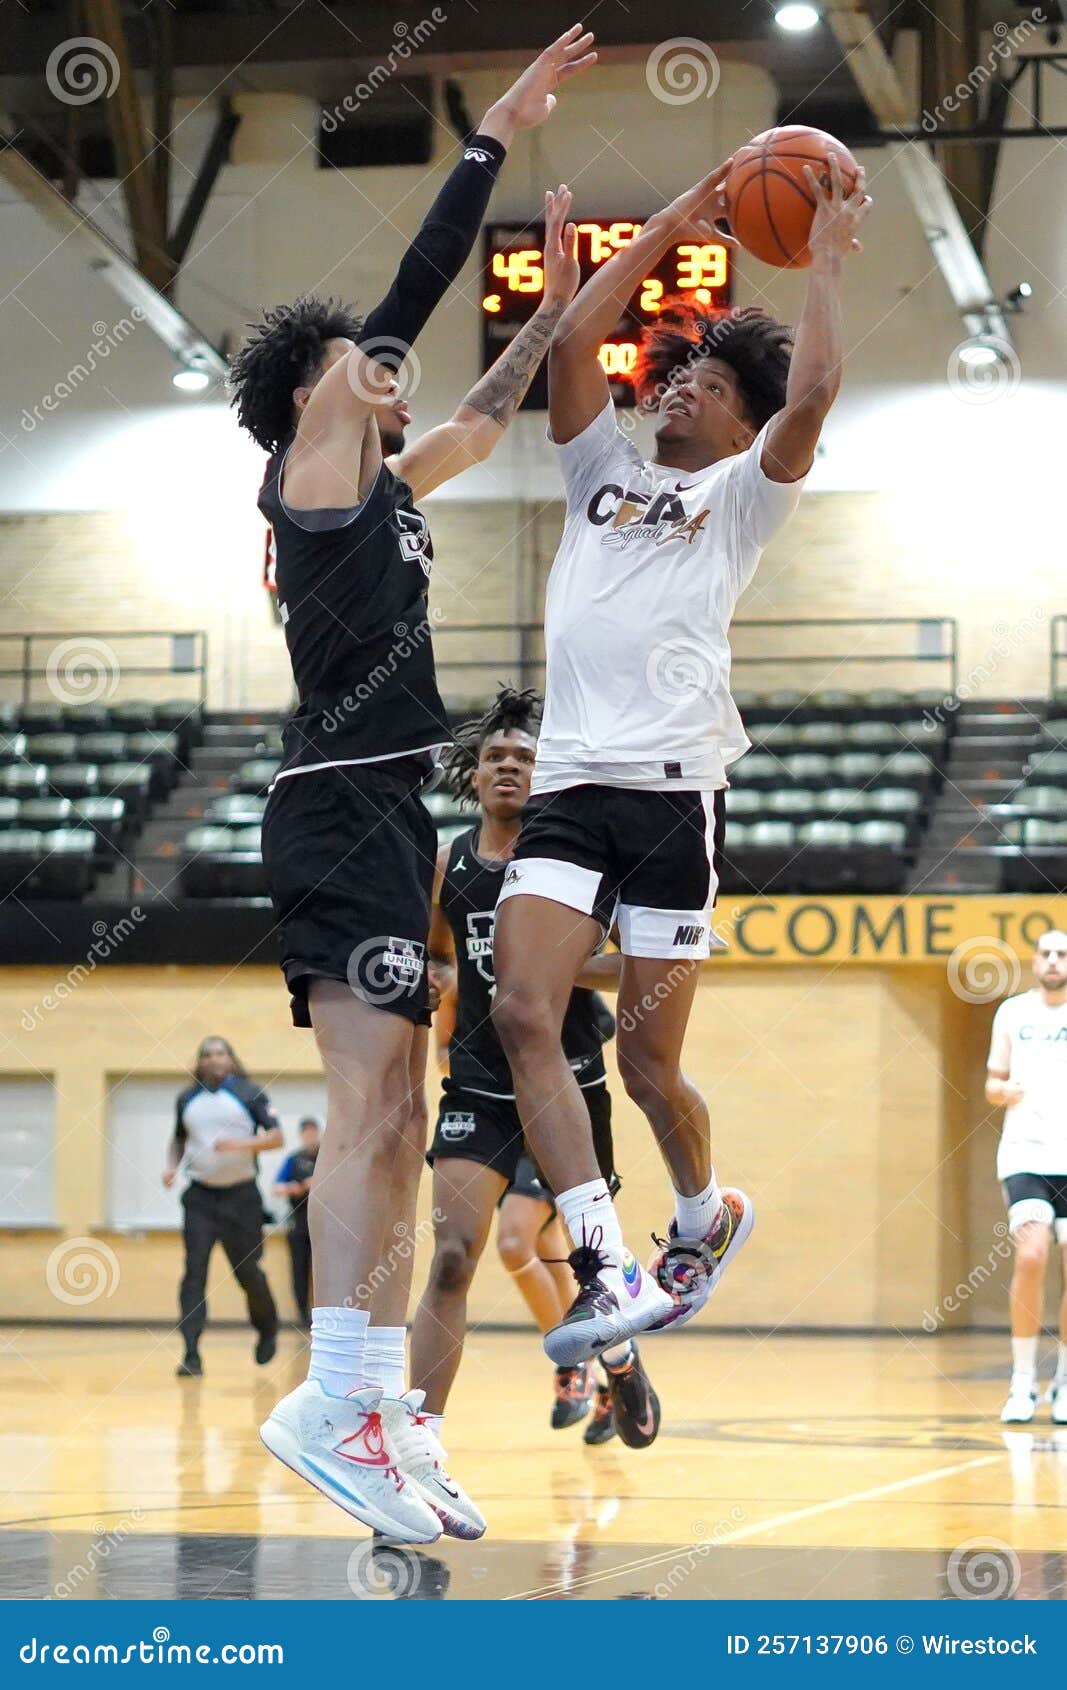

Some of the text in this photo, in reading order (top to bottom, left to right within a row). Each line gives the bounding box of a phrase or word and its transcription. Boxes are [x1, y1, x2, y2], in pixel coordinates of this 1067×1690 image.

[493, 250, 544, 292] 45
[676, 244, 727, 287] 39
[640, 279, 663, 311] 2
[673, 925, 705, 946] NIK
